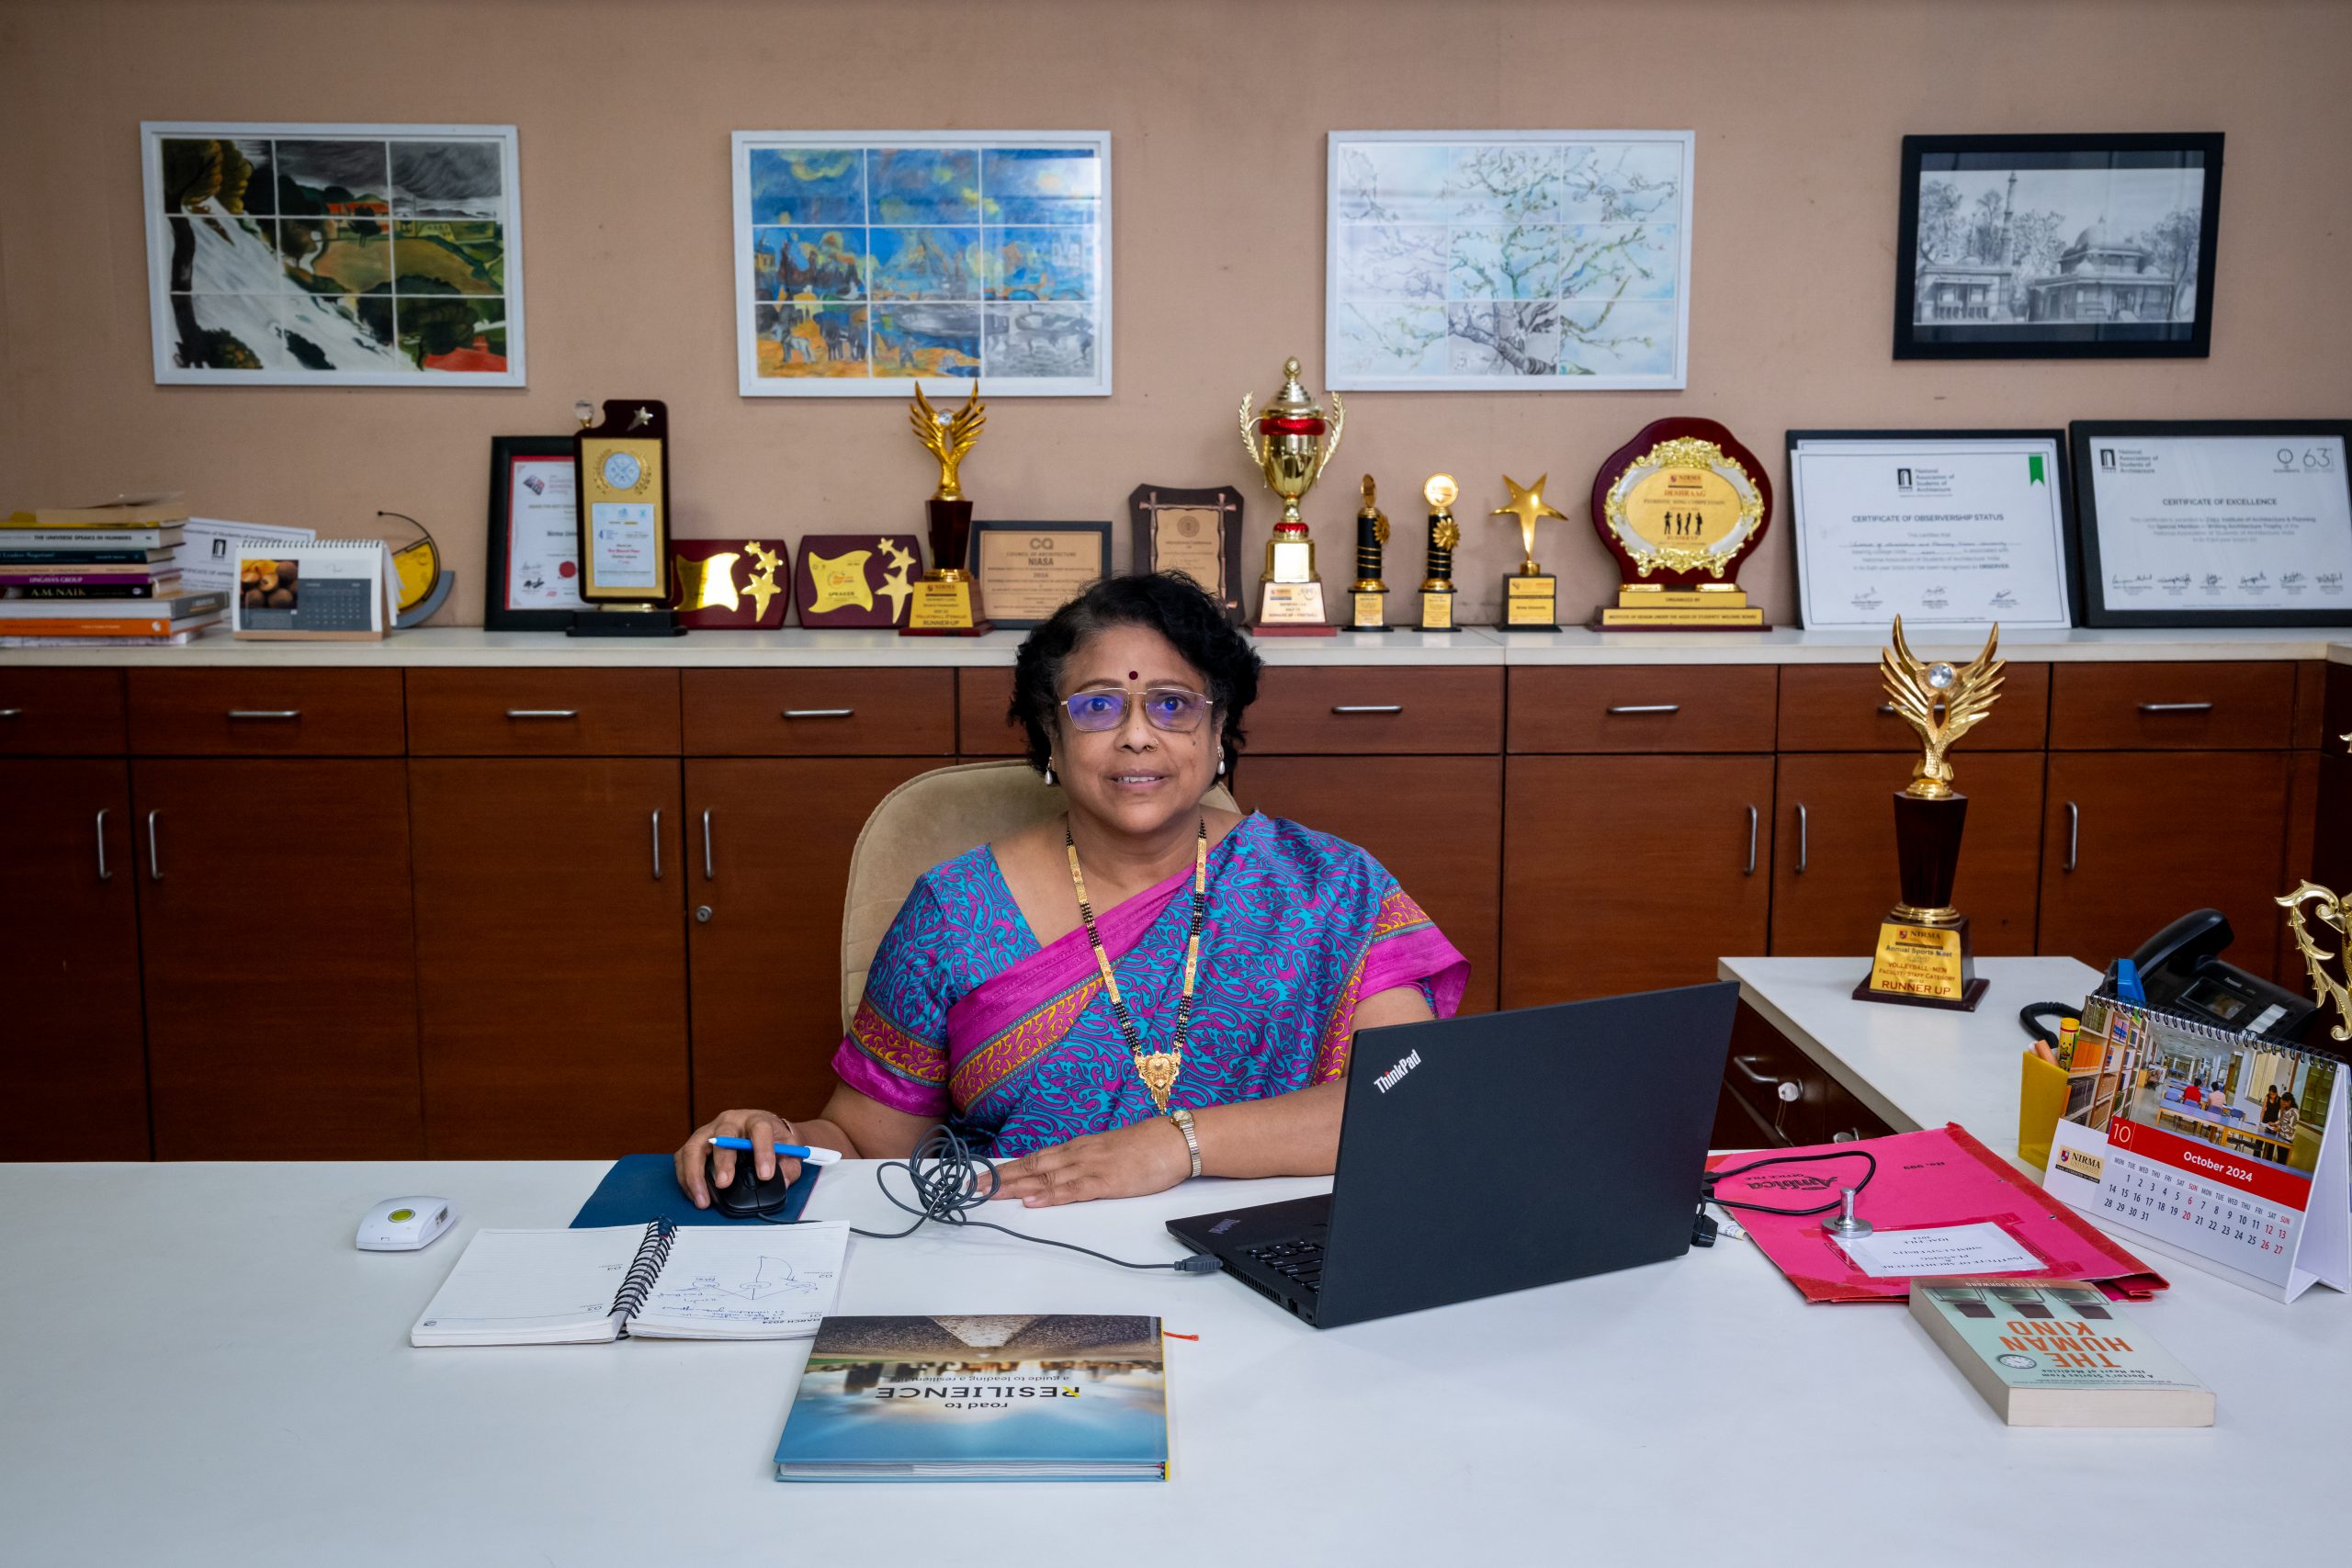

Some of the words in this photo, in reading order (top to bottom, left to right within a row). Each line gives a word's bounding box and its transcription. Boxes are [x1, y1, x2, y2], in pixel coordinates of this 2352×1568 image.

[1851, 514, 1901, 523] CERTIFICATE
[1028, 558, 1054, 566] NIASA
[1910, 930, 1941, 940] NIRMA
[1885, 945, 1910, 953] Annual
[1888, 962, 1928, 971] VOLLEYBALL
[1925, 973, 1955, 981] CATEGORY
[1882, 980, 1932, 993] RUNNER
[1934, 986, 1951, 995] UP
[1374, 1048, 1421, 1093] ThinkPad
[2113, 1122, 2132, 1143] 10
[2072, 1152, 2100, 1169] NIRMA
[2183, 1151, 2224, 1172] October
[2225, 1165, 2253, 1182] 2024
[1747, 1176, 1838, 1190] Ambica
[2105, 1199, 2112, 1207] 28
[2117, 1202, 2124, 1212] 29
[2129, 1207, 2137, 1216] 30
[2141, 1212, 2149, 1221] 31
[2138, 1179, 2143, 1187] 2
[2176, 1191, 2179, 1200] 5
[2214, 1206, 2219, 1214] 8
[2239, 1215, 2246, 1224] 10
[2253, 1220, 2259, 1229] 11
[2266, 1224, 2273, 1235] 12
[2278, 1229, 2286, 1238] 13
[2201, 1188, 2211, 1196] MON
[2228, 1197, 2238, 1205] WED
[2280, 1216, 2290, 1224] SUN
[2109, 1184, 2116, 1193] 14
[2121, 1189, 2129, 1197] 15
[2134, 1193, 2141, 1201] 16
[2146, 1198, 2153, 1206] 17
[2158, 1201, 2165, 1211] 18
[2171, 1206, 2177, 1215] 19
[2182, 1211, 2190, 1220] 20
[2195, 1216, 2203, 1225] 21
[2209, 1221, 2217, 1230] 22
[2222, 1225, 2230, 1235] 23
[2234, 1230, 2243, 1240] 24
[2247, 1235, 2256, 1245] 25
[2261, 1240, 2269, 1249] 26
[2274, 1245, 2283, 1255] 27
[2006, 1321, 2096, 1336] KIND
[1998, 1337, 2133, 1352] HUMAN
[2043, 1352, 2121, 1368] THE
[875, 1386, 1081, 1399] RESILIENCE
